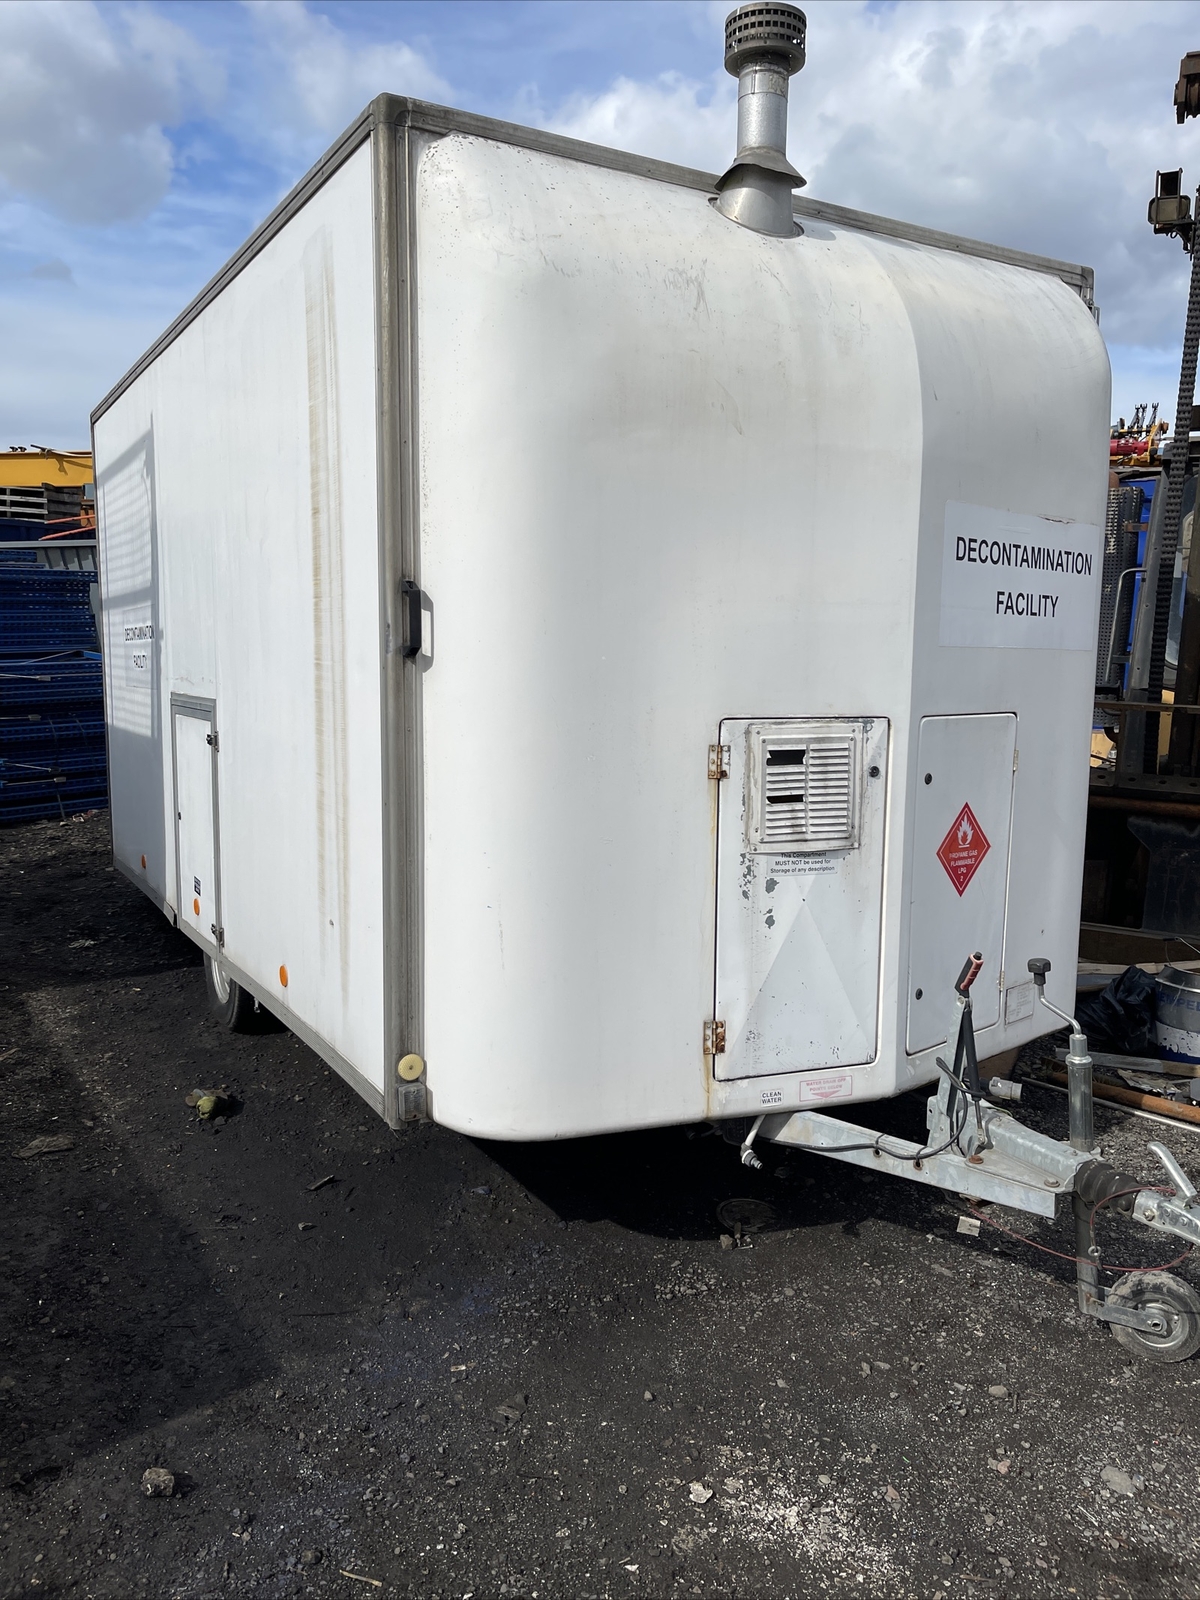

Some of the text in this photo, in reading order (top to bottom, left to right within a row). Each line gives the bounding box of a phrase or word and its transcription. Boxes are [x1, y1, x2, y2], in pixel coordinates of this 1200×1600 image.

[955, 536, 1093, 576] DECONTAMINATION
[996, 591, 1059, 618] FACILITY
[770, 867, 791, 875] Storage
[950, 858, 975, 867] FLAMMABLE
